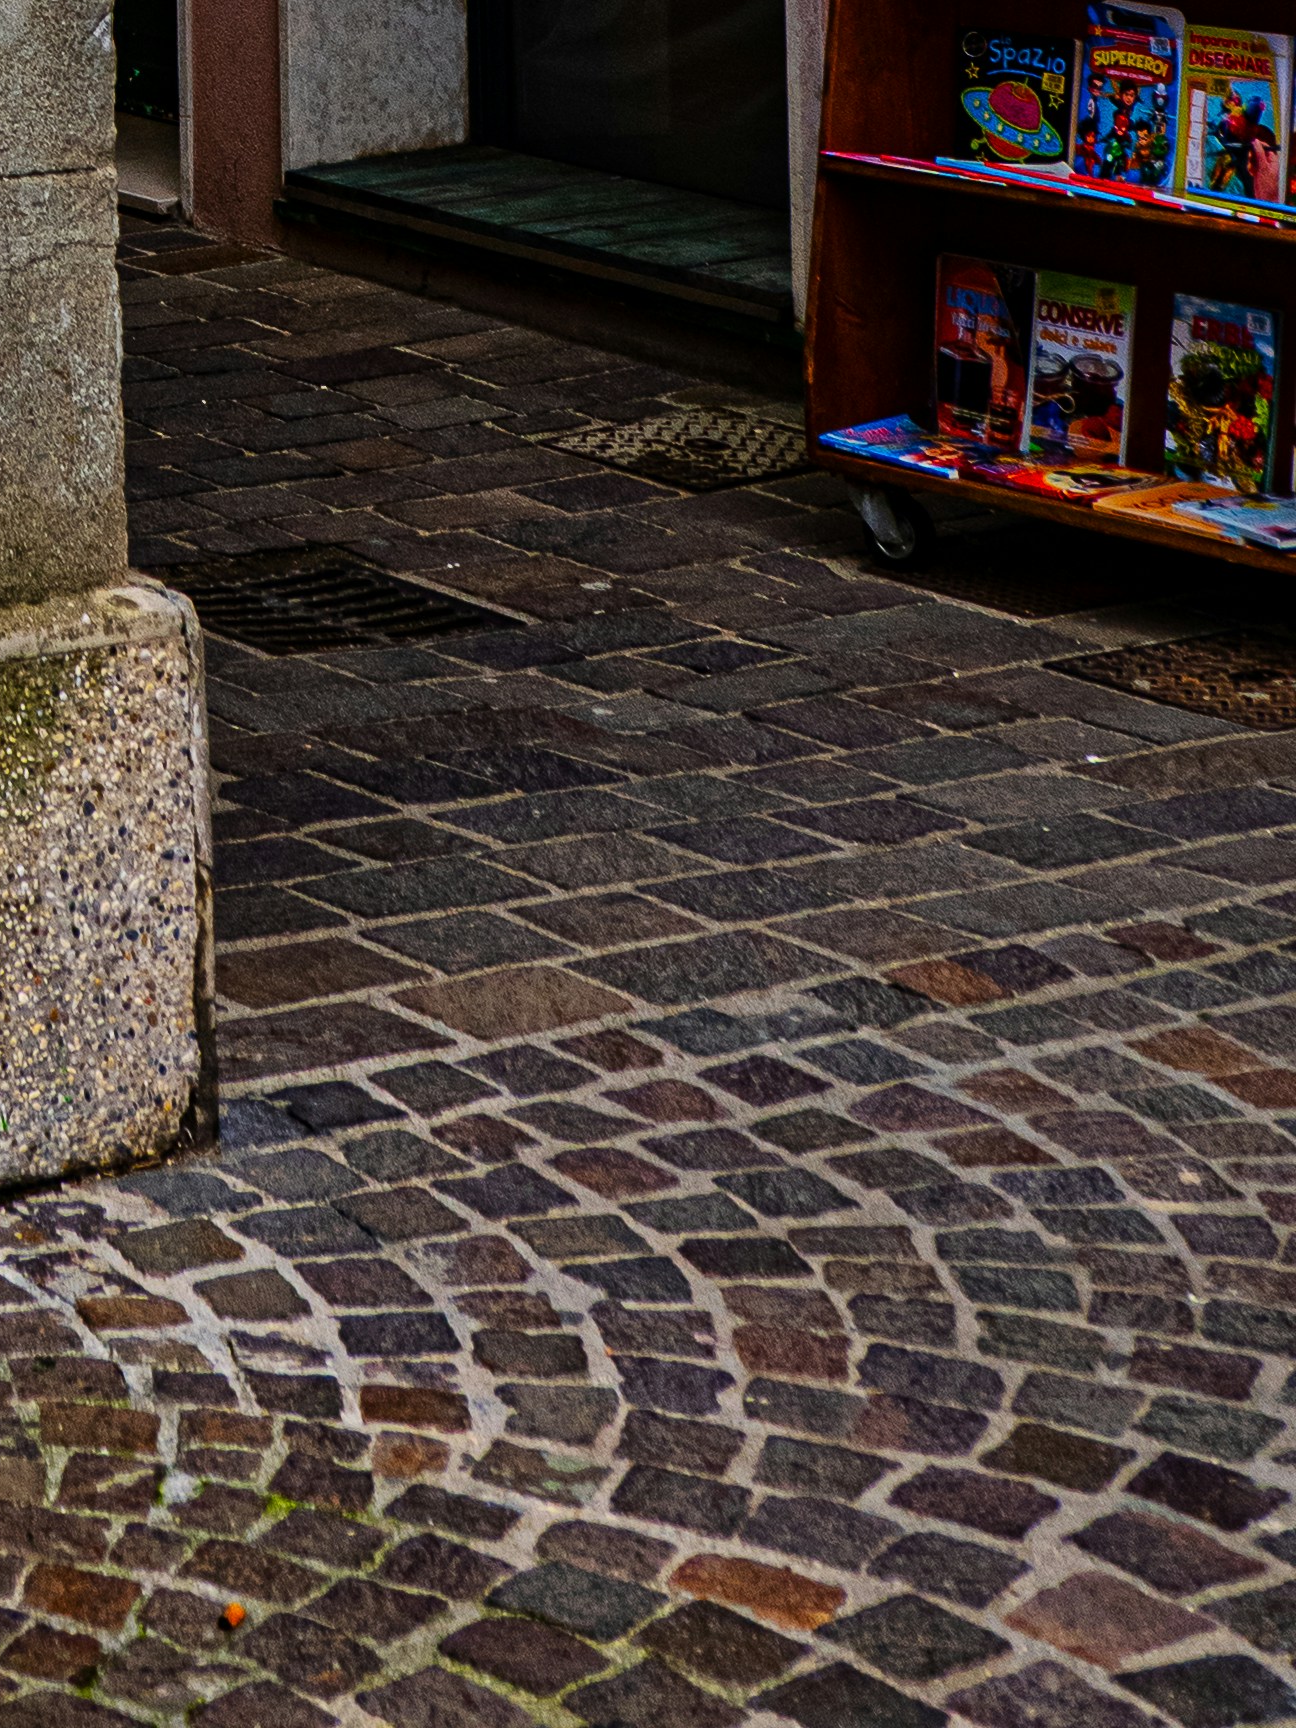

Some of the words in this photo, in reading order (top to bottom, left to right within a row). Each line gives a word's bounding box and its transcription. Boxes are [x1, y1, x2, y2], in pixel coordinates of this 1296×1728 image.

[988, 38, 1068, 75] Spazio
[1092, 49, 1171, 77] SUPEREROI
[1189, 50, 1271, 76] DISEGNARE
[1038, 298, 1125, 336] CONSERVE
